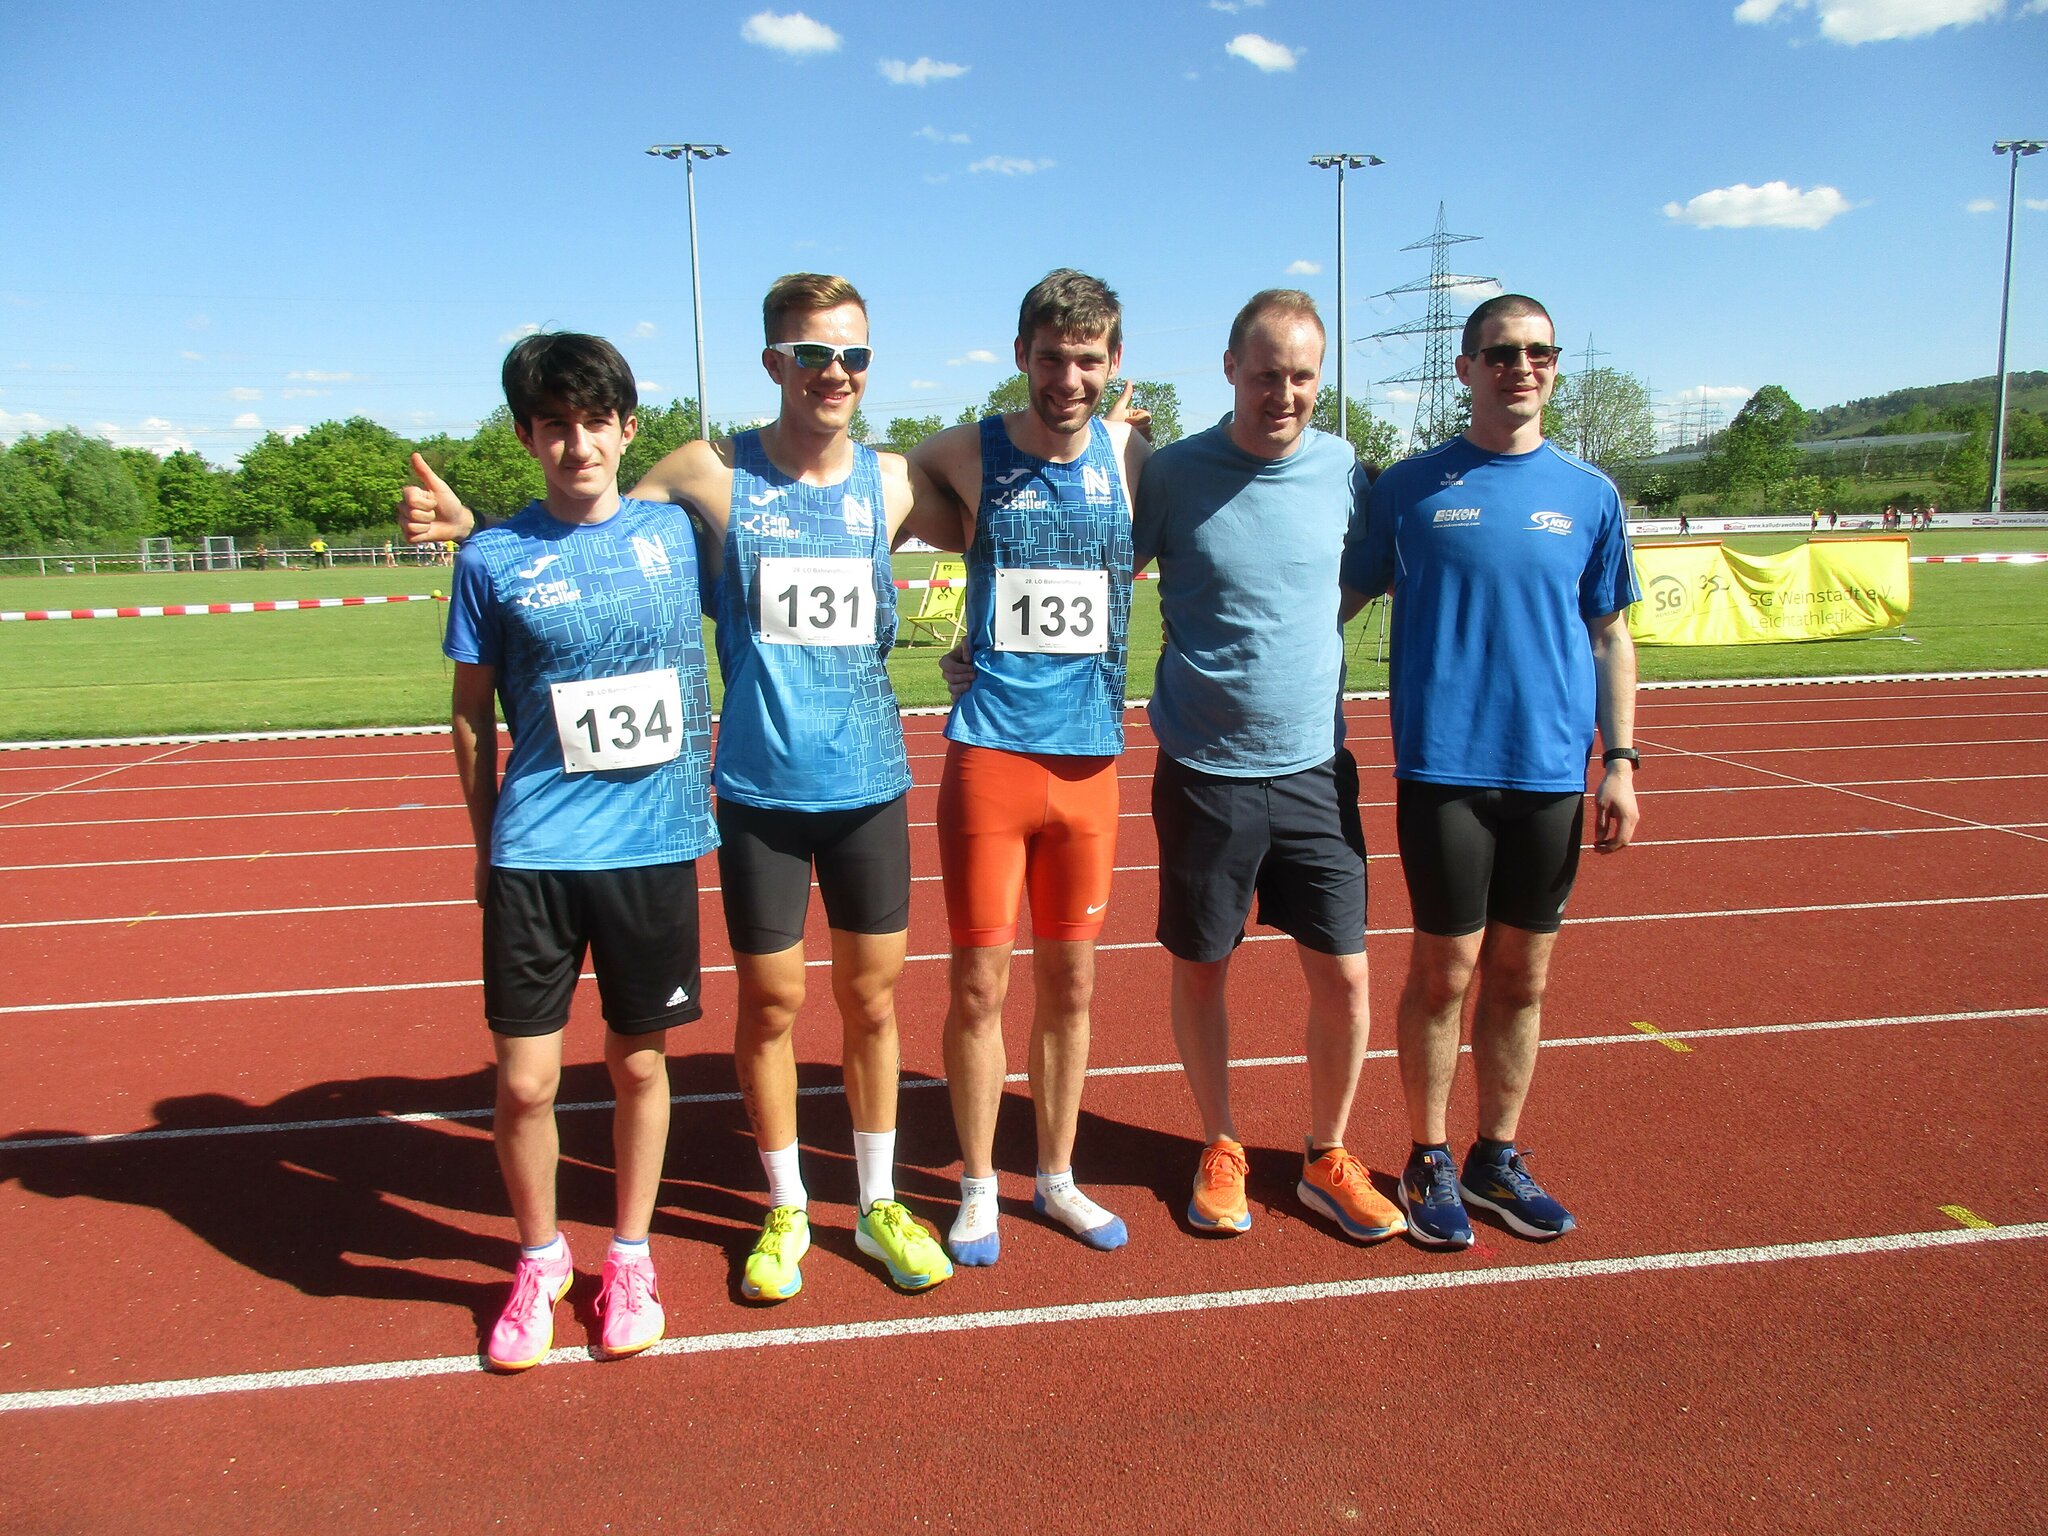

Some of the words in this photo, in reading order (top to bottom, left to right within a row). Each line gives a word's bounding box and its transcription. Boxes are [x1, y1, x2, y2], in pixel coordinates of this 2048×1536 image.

[1011, 489, 1036, 499] Cam
[1011, 499, 1047, 510] Seller
[762, 513, 789, 527] Cam
[762, 525, 799, 539] Seller
[537, 580, 569, 595] Cam
[1749, 592, 1773, 606] SG
[1779, 586, 1861, 605] Weinstadt
[540, 588, 582, 607] Seller
[778, 584, 859, 629] 131
[1655, 588, 1681, 611] SG
[1012, 594, 1095, 637] 133
[1751, 609, 1854, 629] Leichtathletik
[576, 699, 672, 753] 134
